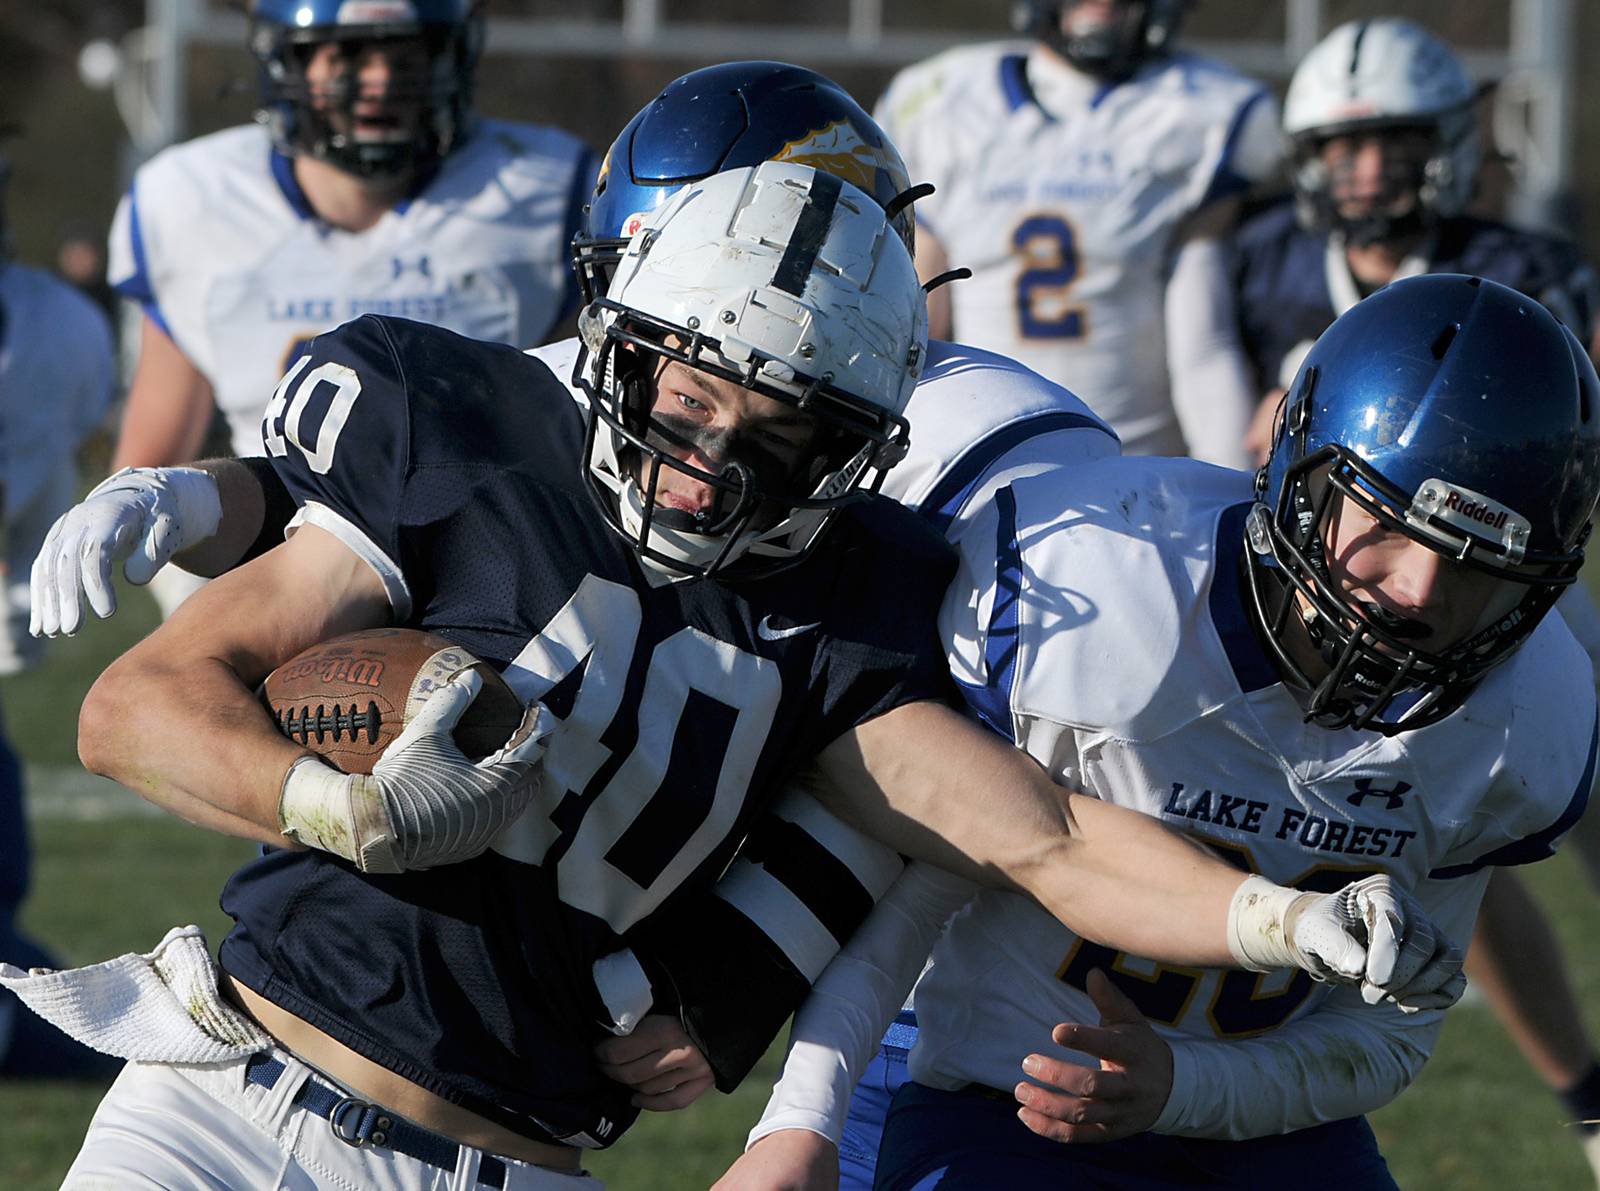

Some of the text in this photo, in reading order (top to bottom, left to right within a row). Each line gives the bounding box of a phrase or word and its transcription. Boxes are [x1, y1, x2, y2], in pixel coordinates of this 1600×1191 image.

[1012, 212, 1092, 343] 2
[261, 355, 362, 475] 40
[1444, 490, 1509, 530] Riddell
[282, 656, 384, 687] Wilson
[488, 572, 783, 936] 40
[1164, 782, 1417, 858] LAKE FOREST
[595, 1116, 614, 1138] M
